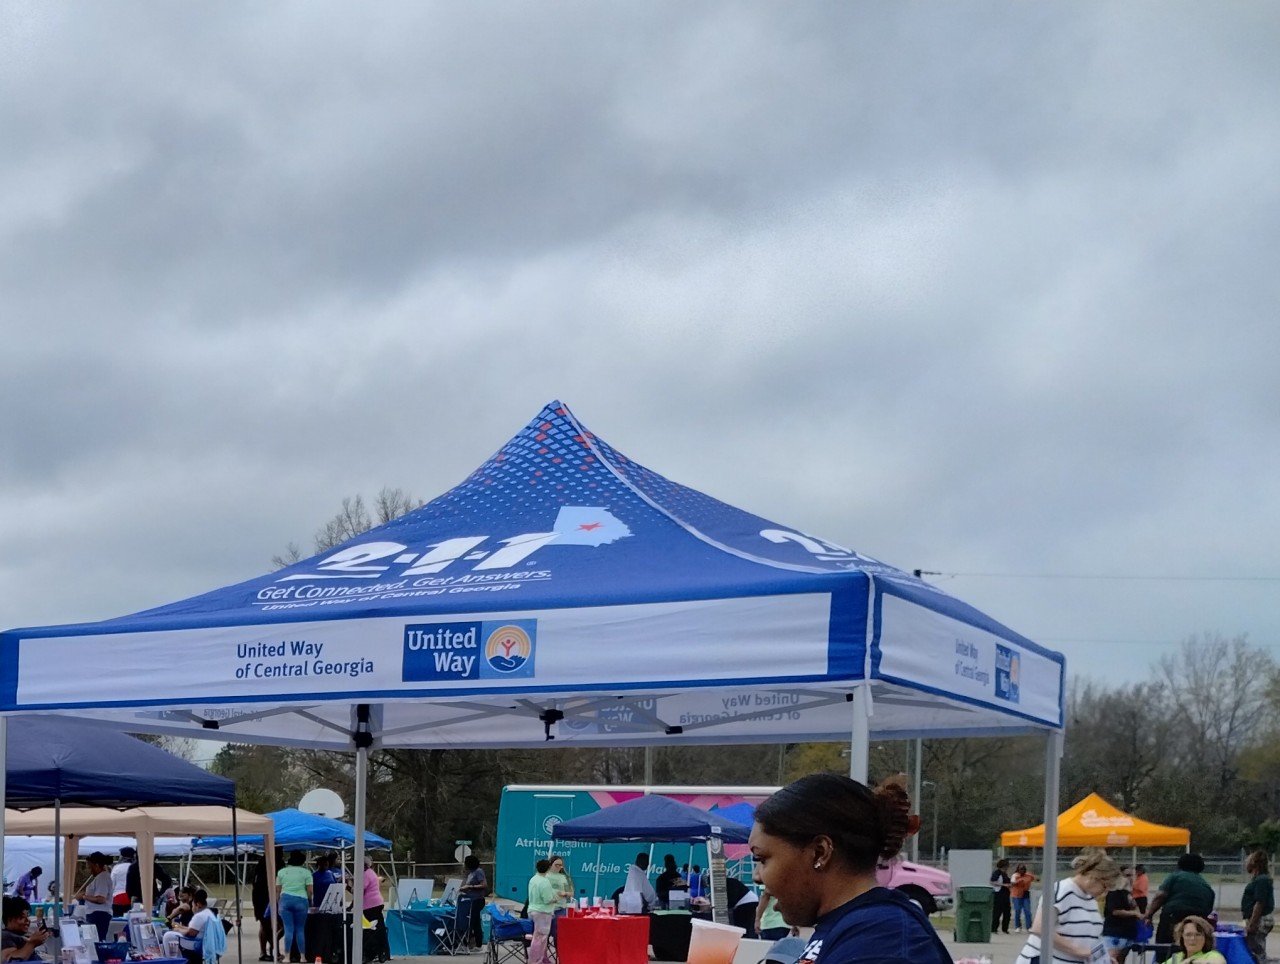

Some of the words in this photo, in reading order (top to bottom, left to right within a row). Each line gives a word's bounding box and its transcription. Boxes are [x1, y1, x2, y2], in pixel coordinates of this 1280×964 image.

[257, 585, 296, 600] Get
[297, 581, 405, 599] Connected.
[412, 576, 451, 588] Get
[447, 570, 552, 584] Answers.
[261, 601, 317, 611] United
[319, 597, 357, 608] Way
[359, 593, 381, 604] of
[382, 588, 446, 600] Central
[450, 583, 521, 596] Georgia
[237, 641, 285, 659] United
[290, 640, 323, 658] Way
[408, 628, 477, 650] United
[235, 663, 252, 679] of
[253, 661, 308, 677] Central
[313, 657, 374, 676] Georgia
[433, 651, 476, 677] Way
[515, 837, 554, 848] Atrium
[555, 838, 592, 848] Health
[581, 862, 621, 873] Mobile
